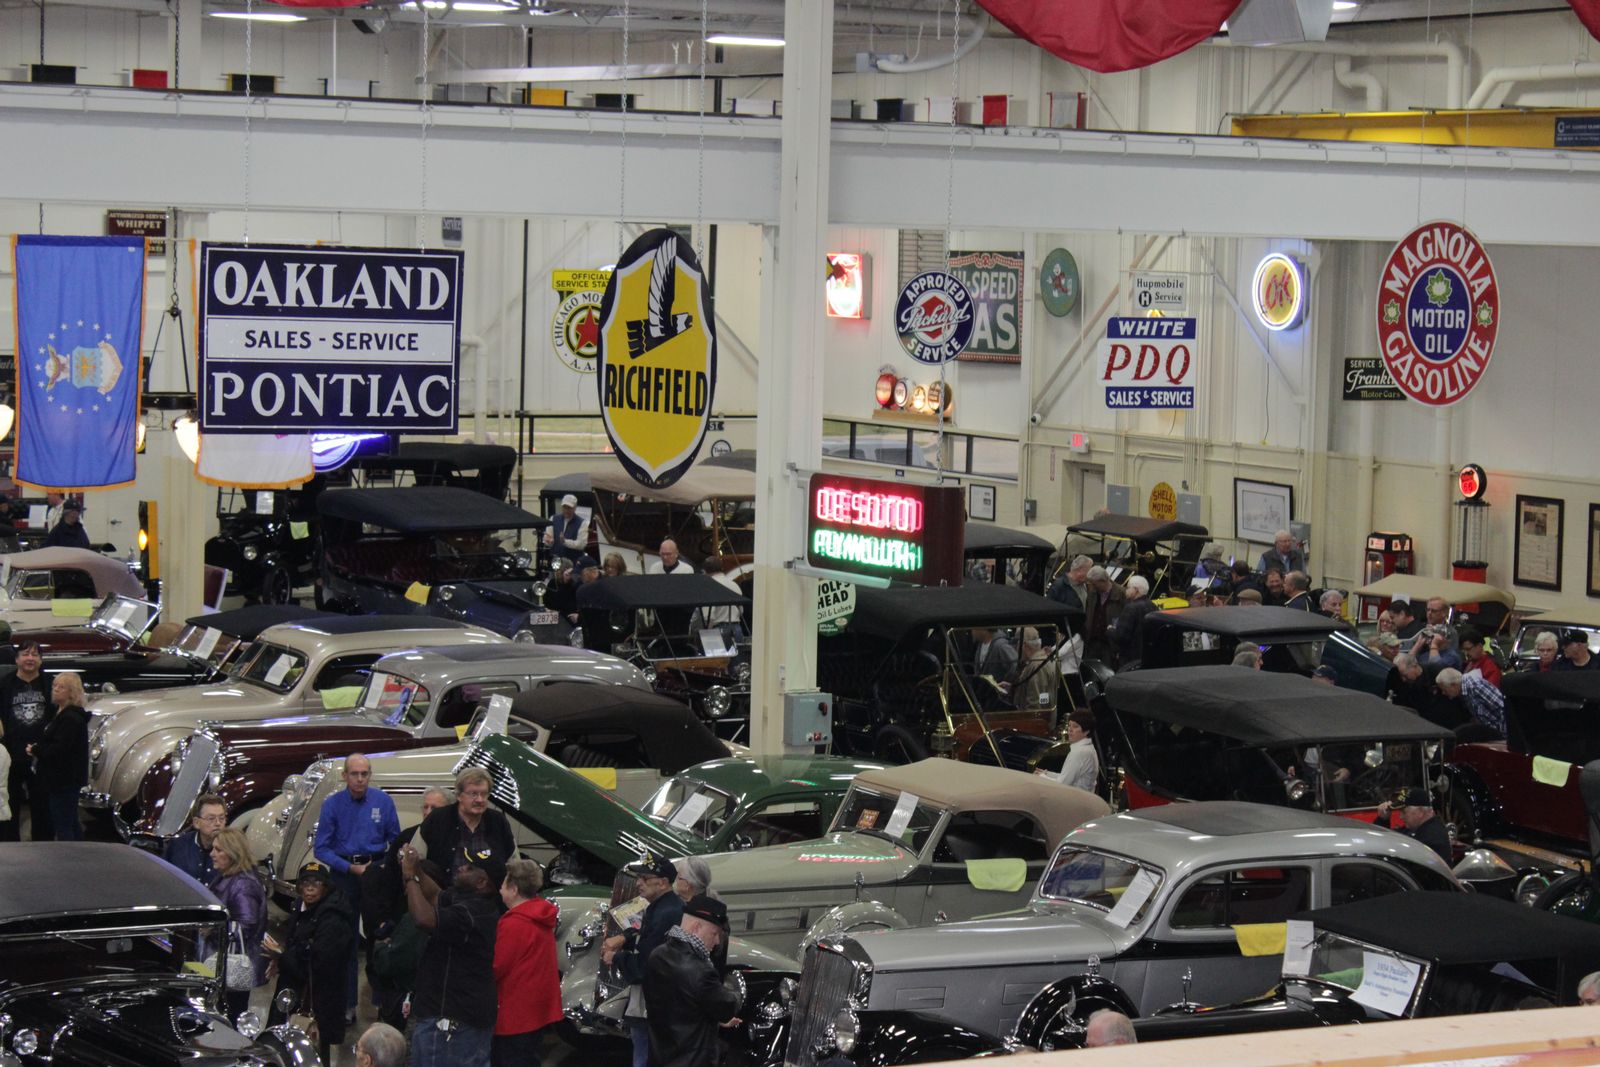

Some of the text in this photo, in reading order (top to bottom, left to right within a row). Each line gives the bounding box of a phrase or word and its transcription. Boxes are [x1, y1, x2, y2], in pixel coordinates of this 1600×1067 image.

[116, 220, 162, 229] WHIPPET
[1385, 228, 1492, 300] MAGNOLIA
[213, 259, 450, 311] OAKLAND
[555, 280, 589, 288] SERVICE
[905, 274, 966, 303] APPROVED
[1136, 278, 1185, 290] Hupmobile
[1265, 267, 1294, 311] OK
[1155, 291, 1183, 301] Service
[554, 297, 579, 348] CHICAGO
[898, 300, 971, 333] Packard
[971, 302, 1017, 351] AS
[1411, 308, 1466, 329] MOTOR
[1117, 320, 1187, 337] WHITE
[244, 329, 312, 349] SALES
[332, 331, 420, 351] SERVICE
[906, 337, 962, 361] SERVICE
[1425, 333, 1453, 354] OIL
[1102, 343, 1191, 385] PDQ
[1350, 360, 1376, 368] SERVICE
[1385, 330, 1491, 400] GASOLINE
[210, 371, 450, 418] PONTIAC
[603, 363, 708, 417] RICHFIELD
[1108, 390, 1192, 406] SALES & SERVICE
[1152, 490, 1172, 503] SHELL
[1152, 503, 1172, 513] MOTOR
[817, 590, 849, 610] HEAD
